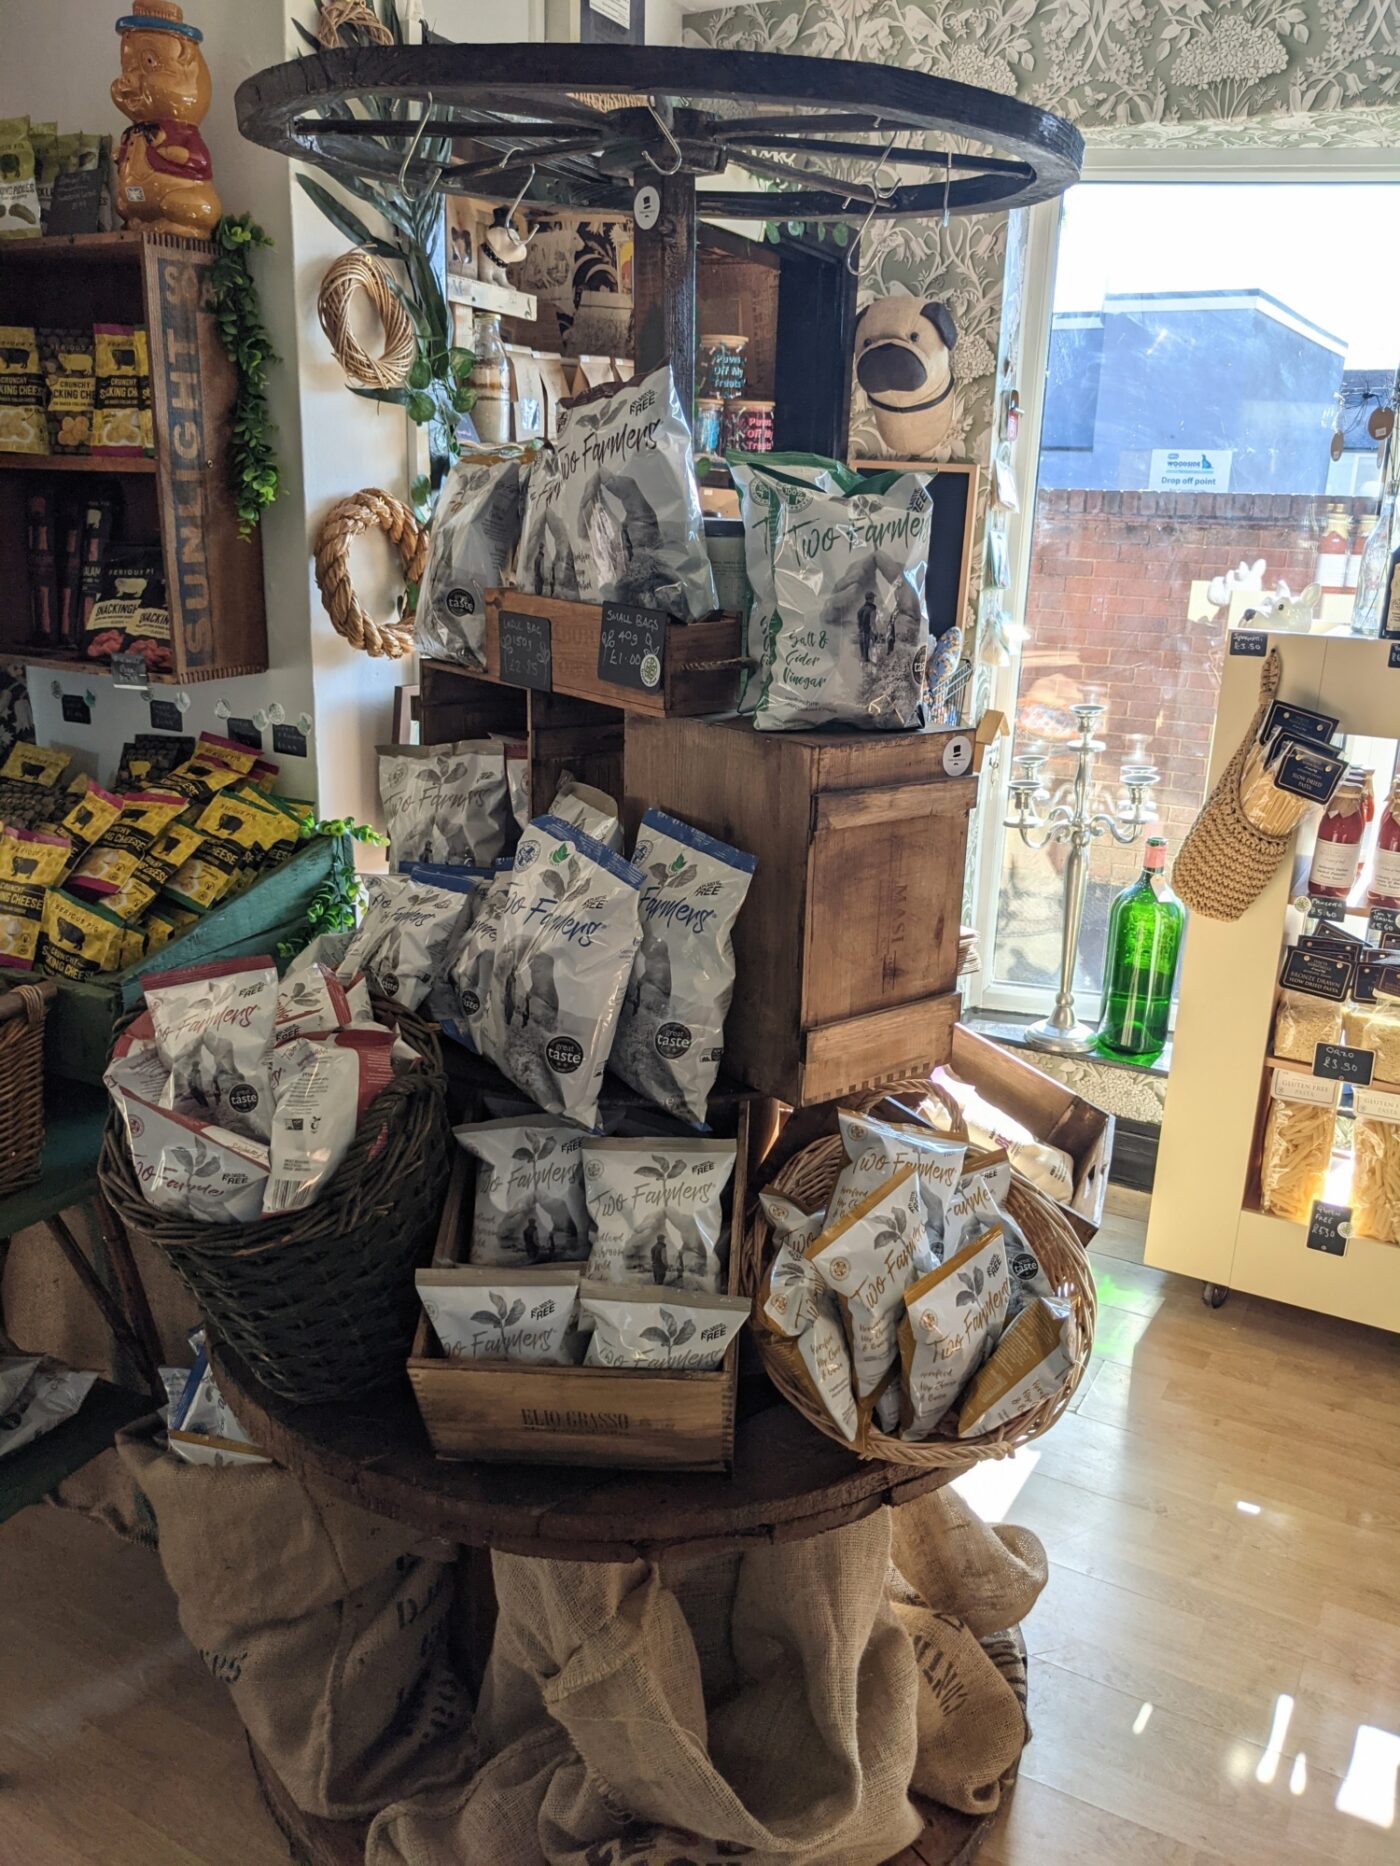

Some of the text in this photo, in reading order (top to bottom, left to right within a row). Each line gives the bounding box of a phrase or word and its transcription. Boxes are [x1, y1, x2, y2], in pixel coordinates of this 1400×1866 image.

[630, 396, 656, 416] FREE
[582, 418, 662, 472] Farmers
[1161, 475, 1216, 486] Drop off point
[167, 328, 212, 654] SUNLIGHT
[782, 517, 841, 567] Two
[606, 609, 660, 632] SMALL BAGS
[618, 630, 639, 646] 40g
[788, 630, 829, 649] Salt &
[783, 667, 827, 690] Vinegar
[638, 886, 714, 934] Farmers
[657, 1033, 691, 1049] taste
[548, 1048, 581, 1064] taste
[1326, 1046, 1355, 1059] ORZO
[1281, 1080, 1329, 1093] GLUTEN FREE
[231, 1094, 257, 1105] taste
[507, 1161, 577, 1191] Farmers
[588, 1180, 714, 1220] Two Farmers
[1014, 1261, 1038, 1273] taste
[850, 1275, 887, 1313] Two
[530, 1303, 556, 1321] FREE
[471, 1327, 555, 1361] Farmers
[701, 1327, 727, 1343] FREE
[521, 1408, 560, 1426] ELIO
[566, 1409, 629, 1430] GRASSO
